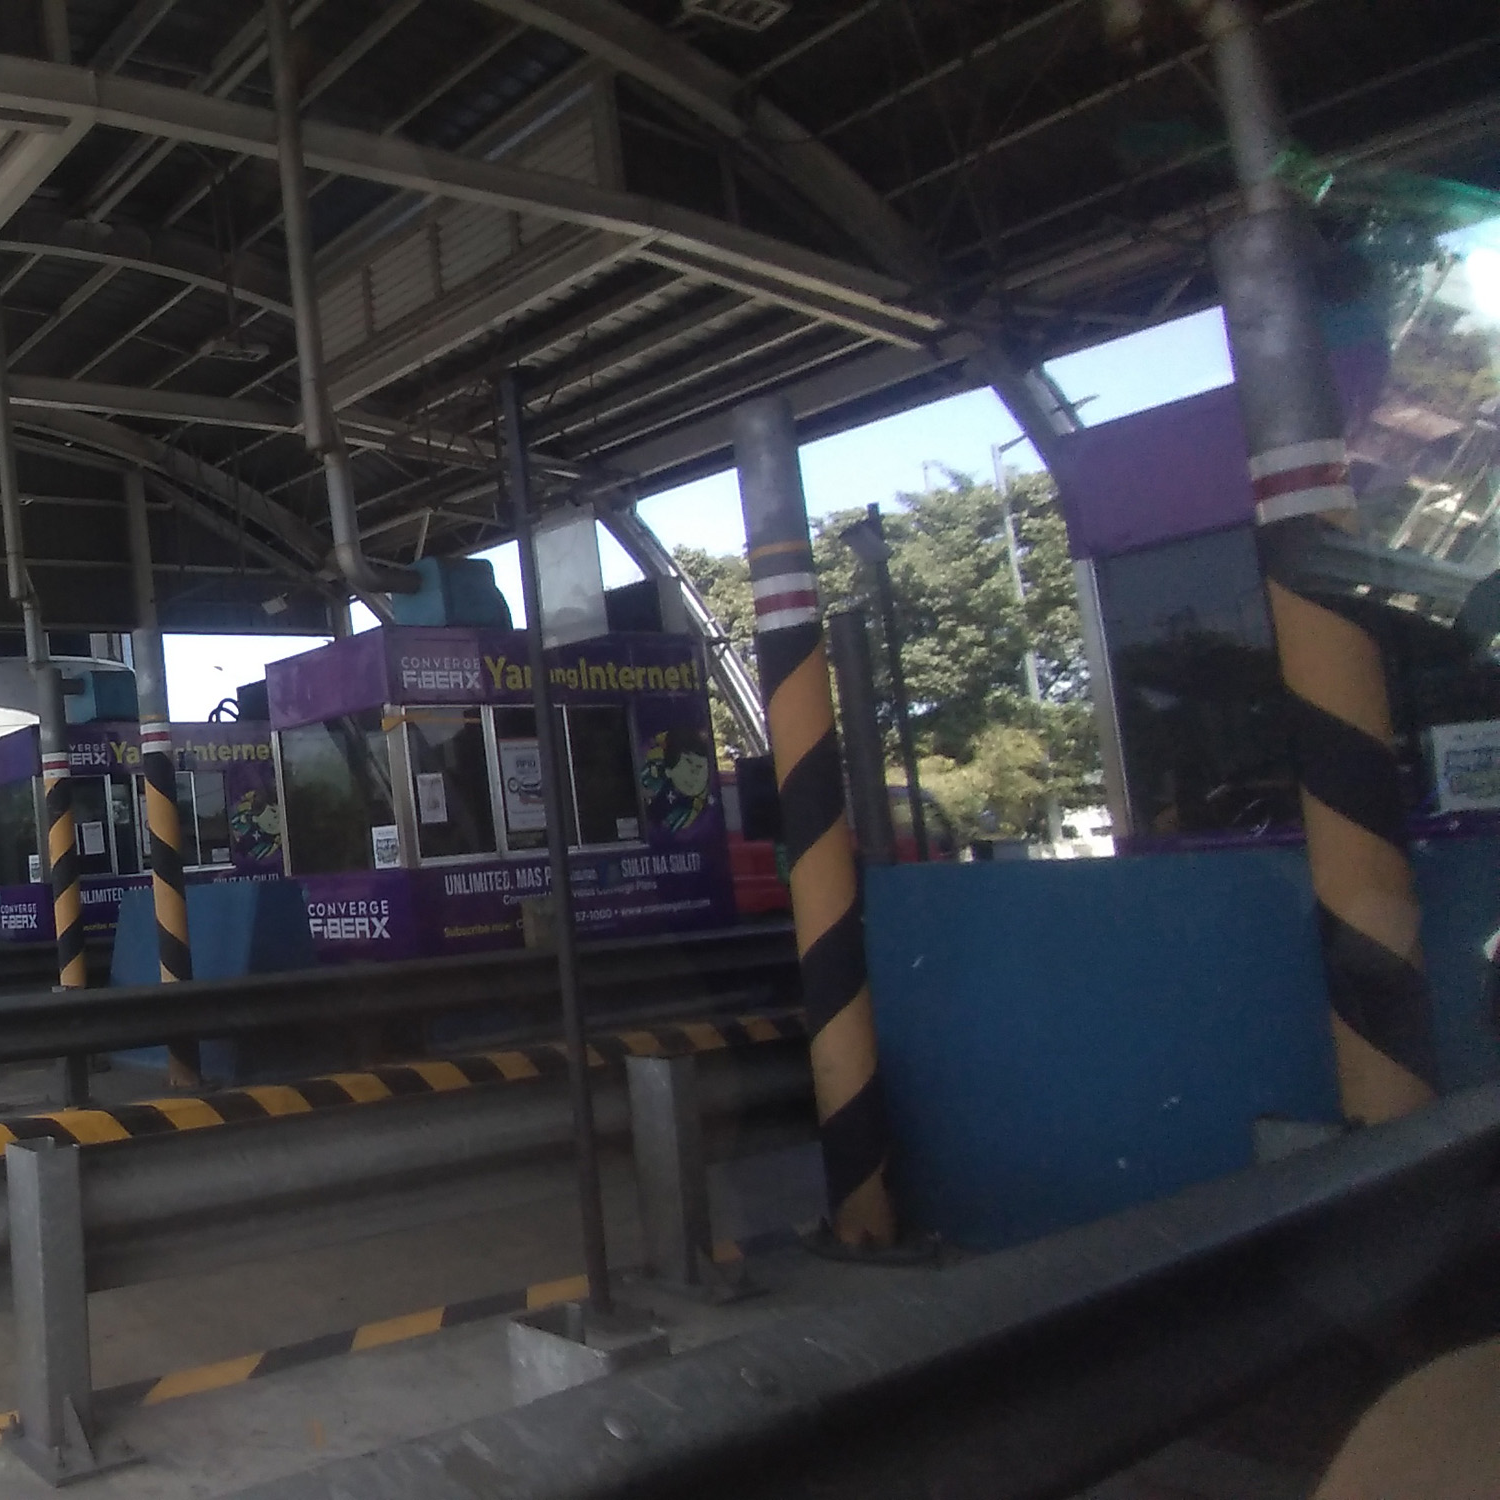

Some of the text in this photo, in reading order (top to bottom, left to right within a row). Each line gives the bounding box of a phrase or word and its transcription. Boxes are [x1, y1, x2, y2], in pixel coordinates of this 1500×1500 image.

[401, 656, 481, 670] CONVERGE
[515, 866, 543, 889] MAS
[0, 903, 37, 914] CONVERGE
[307, 899, 389, 917] CONVERGE
